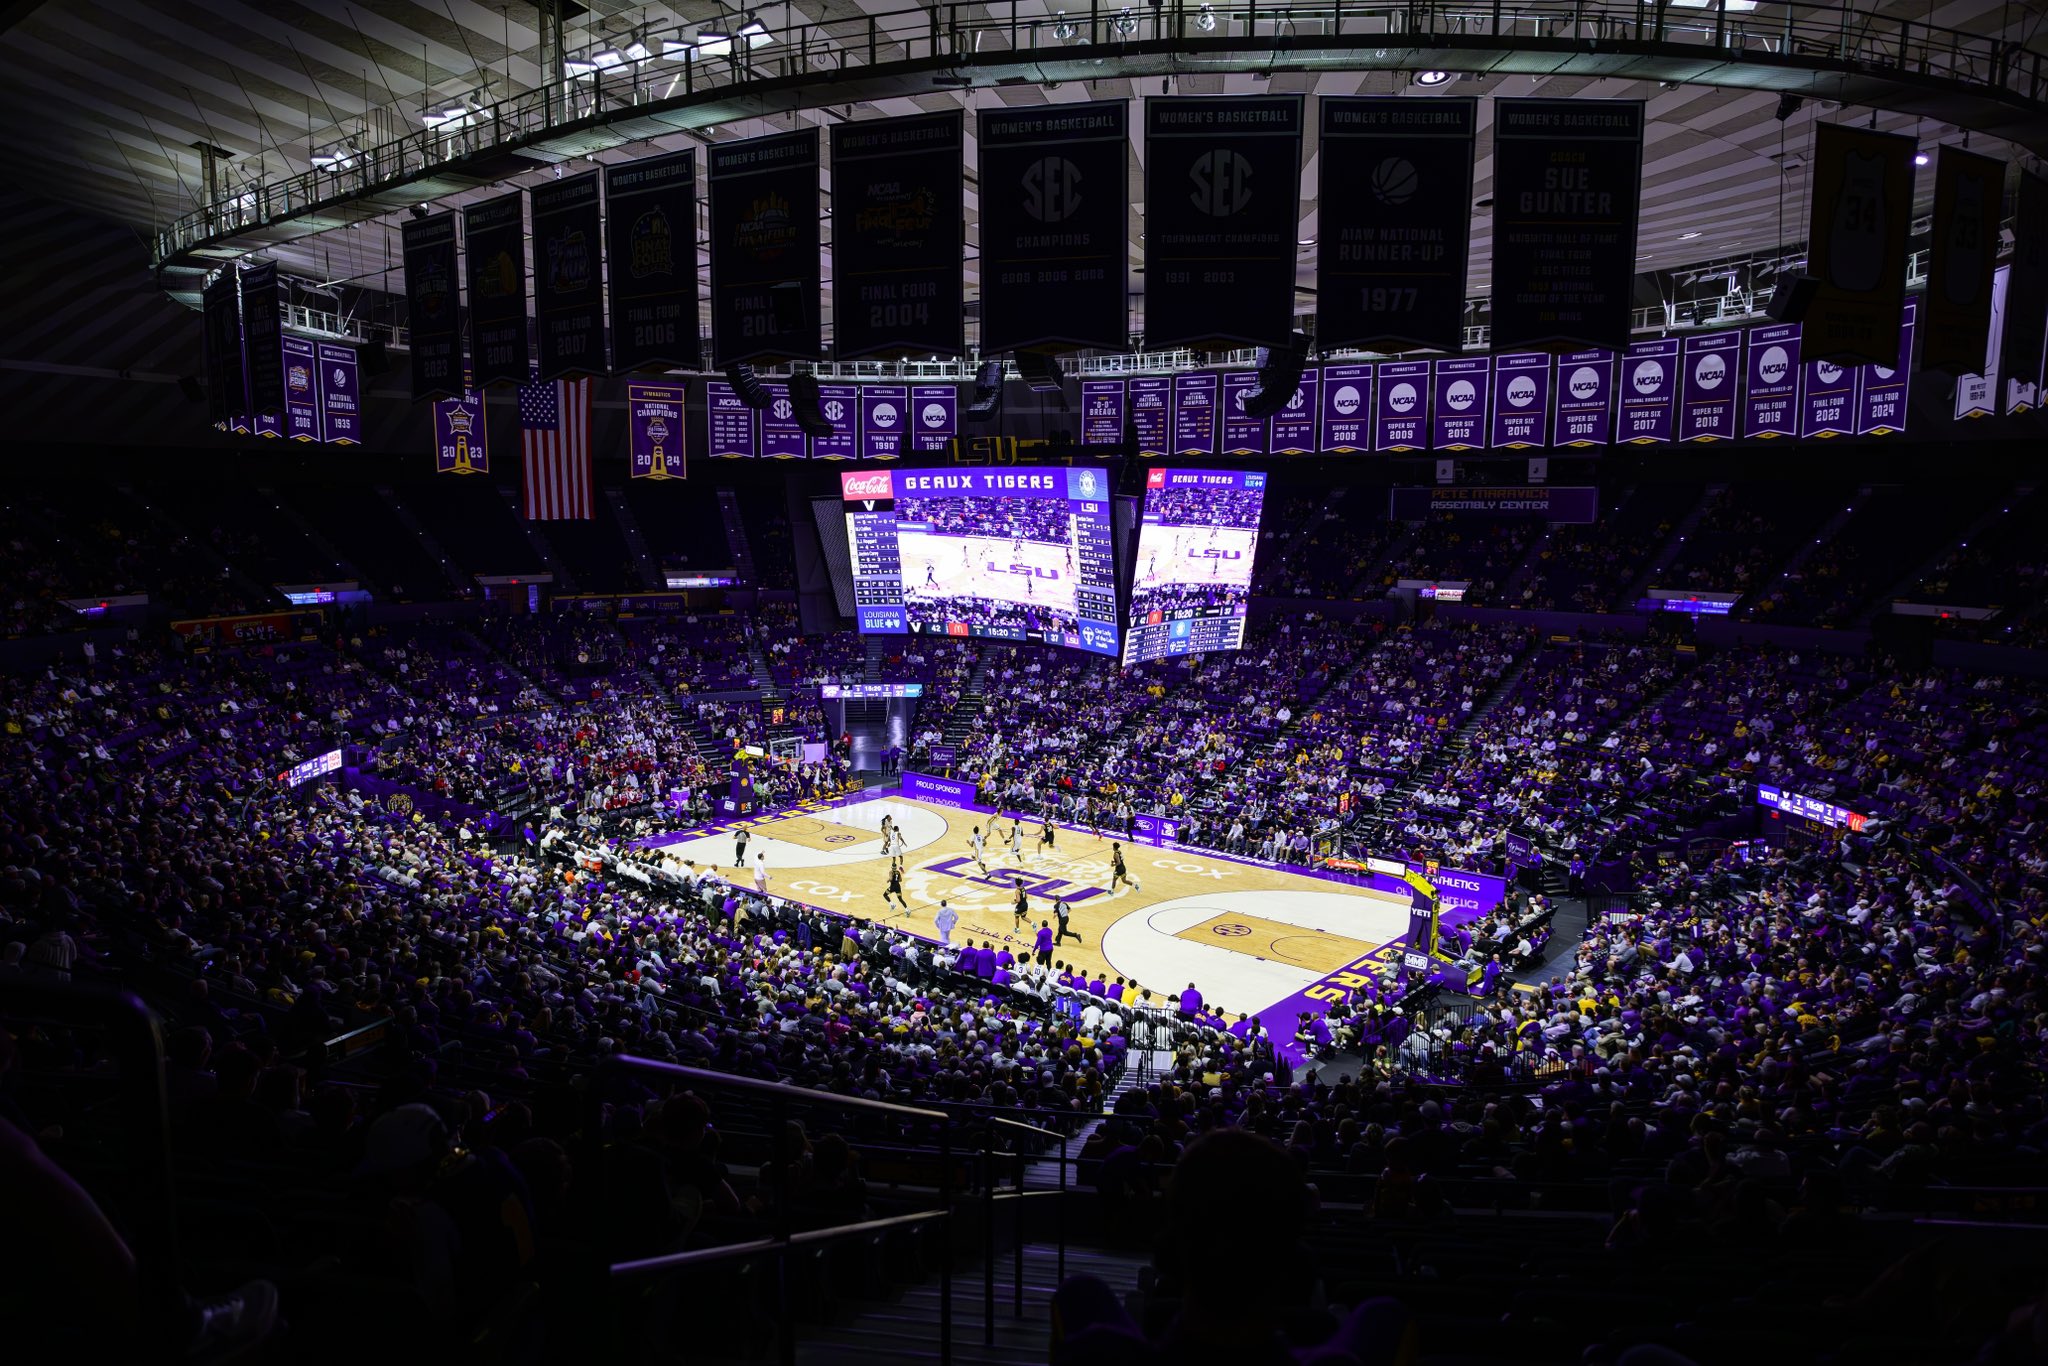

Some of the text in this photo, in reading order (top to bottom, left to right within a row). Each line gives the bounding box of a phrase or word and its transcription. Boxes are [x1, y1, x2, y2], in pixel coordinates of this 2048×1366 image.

[1160, 109, 1288, 125] WOMEN'S BASKETBALL
[1333, 111, 1462, 125] WOMEN'S BASKETBALL
[1508, 113, 1631, 128] WOMEN'S BASKETBALL
[991, 115, 1115, 136] WOMEN'S BASKETBALL
[842, 125, 951, 149] WOMEN'S BASKETBALL
[717, 146, 808, 171] WOMEN'S BASKETBALL
[612, 163, 688, 187] WOMEN'S BASKETBALL
[1545, 167, 1591, 190] SUE
[1021, 156, 1083, 222] SEC
[1189, 149, 1253, 216] SEC
[1519, 191, 1614, 214] GUNTER
[1161, 233, 1280, 244] TOURNAMENT CHAMPIONS
[1340, 227, 1445, 241] AIAW NATIONAL
[1016, 233, 1091, 249] CHAMPIONS
[1338, 244, 1446, 262] RUNNER-UP
[861, 280, 937, 301] FINAL FOUR
[735, 297, 766, 313] FINAL
[1360, 287, 1419, 313] 1977
[628, 303, 681, 323] FINAL FOUR
[870, 303, 930, 328] 2004
[552, 314, 592, 334] FINAL FOUR
[743, 314, 779, 337] 200
[634, 323, 677, 347] 2006
[1763, 329, 1790, 339] GYMNASTICS
[556, 334, 588, 358] 2007
[1698, 338, 1727, 347] GYMNASTICS
[1636, 345, 1665, 354] GYMNASTICS
[1762, 362, 1787, 375] NCAA
[1636, 376, 1663, 386] NCAA
[1698, 370, 1724, 382] NCAA
[1572, 382, 1598, 391] NCAA
[1509, 391, 1535, 400] NCAA
[1869, 392, 1899, 403] FINAL FOUR
[644, 403, 669, 411] NATIONAL
[719, 398, 742, 407] NCAA
[1754, 400, 1787, 412] FINAL FOUR
[1813, 397, 1845, 408] FINAL FOUR
[637, 409, 679, 419] CHAMPIONS
[825, 401, 844, 421] SEC
[1089, 408, 1117, 416] BREAUX
[1630, 411, 1649, 419] SUPER
[1693, 406, 1724, 416] SUPER SIX
[1815, 407, 1840, 422] 2023
[1872, 403, 1895, 418] 2024
[1525, 417, 1535, 425] SIX
[1695, 417, 1719, 428] 2018
[1758, 411, 1781, 424] 2019
[1507, 426, 1531, 436] 2014
[1569, 424, 1593, 434] 2016
[1633, 419, 1656, 431] 2017
[1333, 432, 1356, 441] 2008
[1390, 430, 1414, 439] 2009
[1447, 429, 1470, 438] 2013
[442, 446, 483, 459] 20 23
[875, 442, 896, 450] 1990
[925, 442, 942, 450] 1991
[637, 455, 681, 467] 20 24
[905, 475, 1055, 489] GEAUX TIGERS
[1172, 475, 1233, 485] GEAUX TIGERS
[1432, 489, 1550, 499] PETE MARAVICH
[1080, 502, 1098, 513] LSU
[1430, 500, 1549, 510] ASSEMBLY CENTER
[1187, 548, 1241, 560] LSU
[863, 611, 900, 619] LOUISIANA
[865, 619, 885, 628] BLUE
[930, 624, 942, 632] 42
[987, 627, 1009, 637] 15:20
[1050, 633, 1059, 643] 37
[916, 780, 961, 795] PROUD SPONSOR
[1759, 789, 1778, 803] YETI
[1805, 799, 1824, 813] 15:20
[1780, 799, 1791, 811] 42
[683, 804, 833, 837] TIGERS
[1152, 860, 1234, 880] COX
[922, 857, 1109, 903] LSU
[1431, 876, 1480, 892] ATHLETICS
[788, 879, 866, 903] COX
[1411, 907, 1431, 918] YETI
